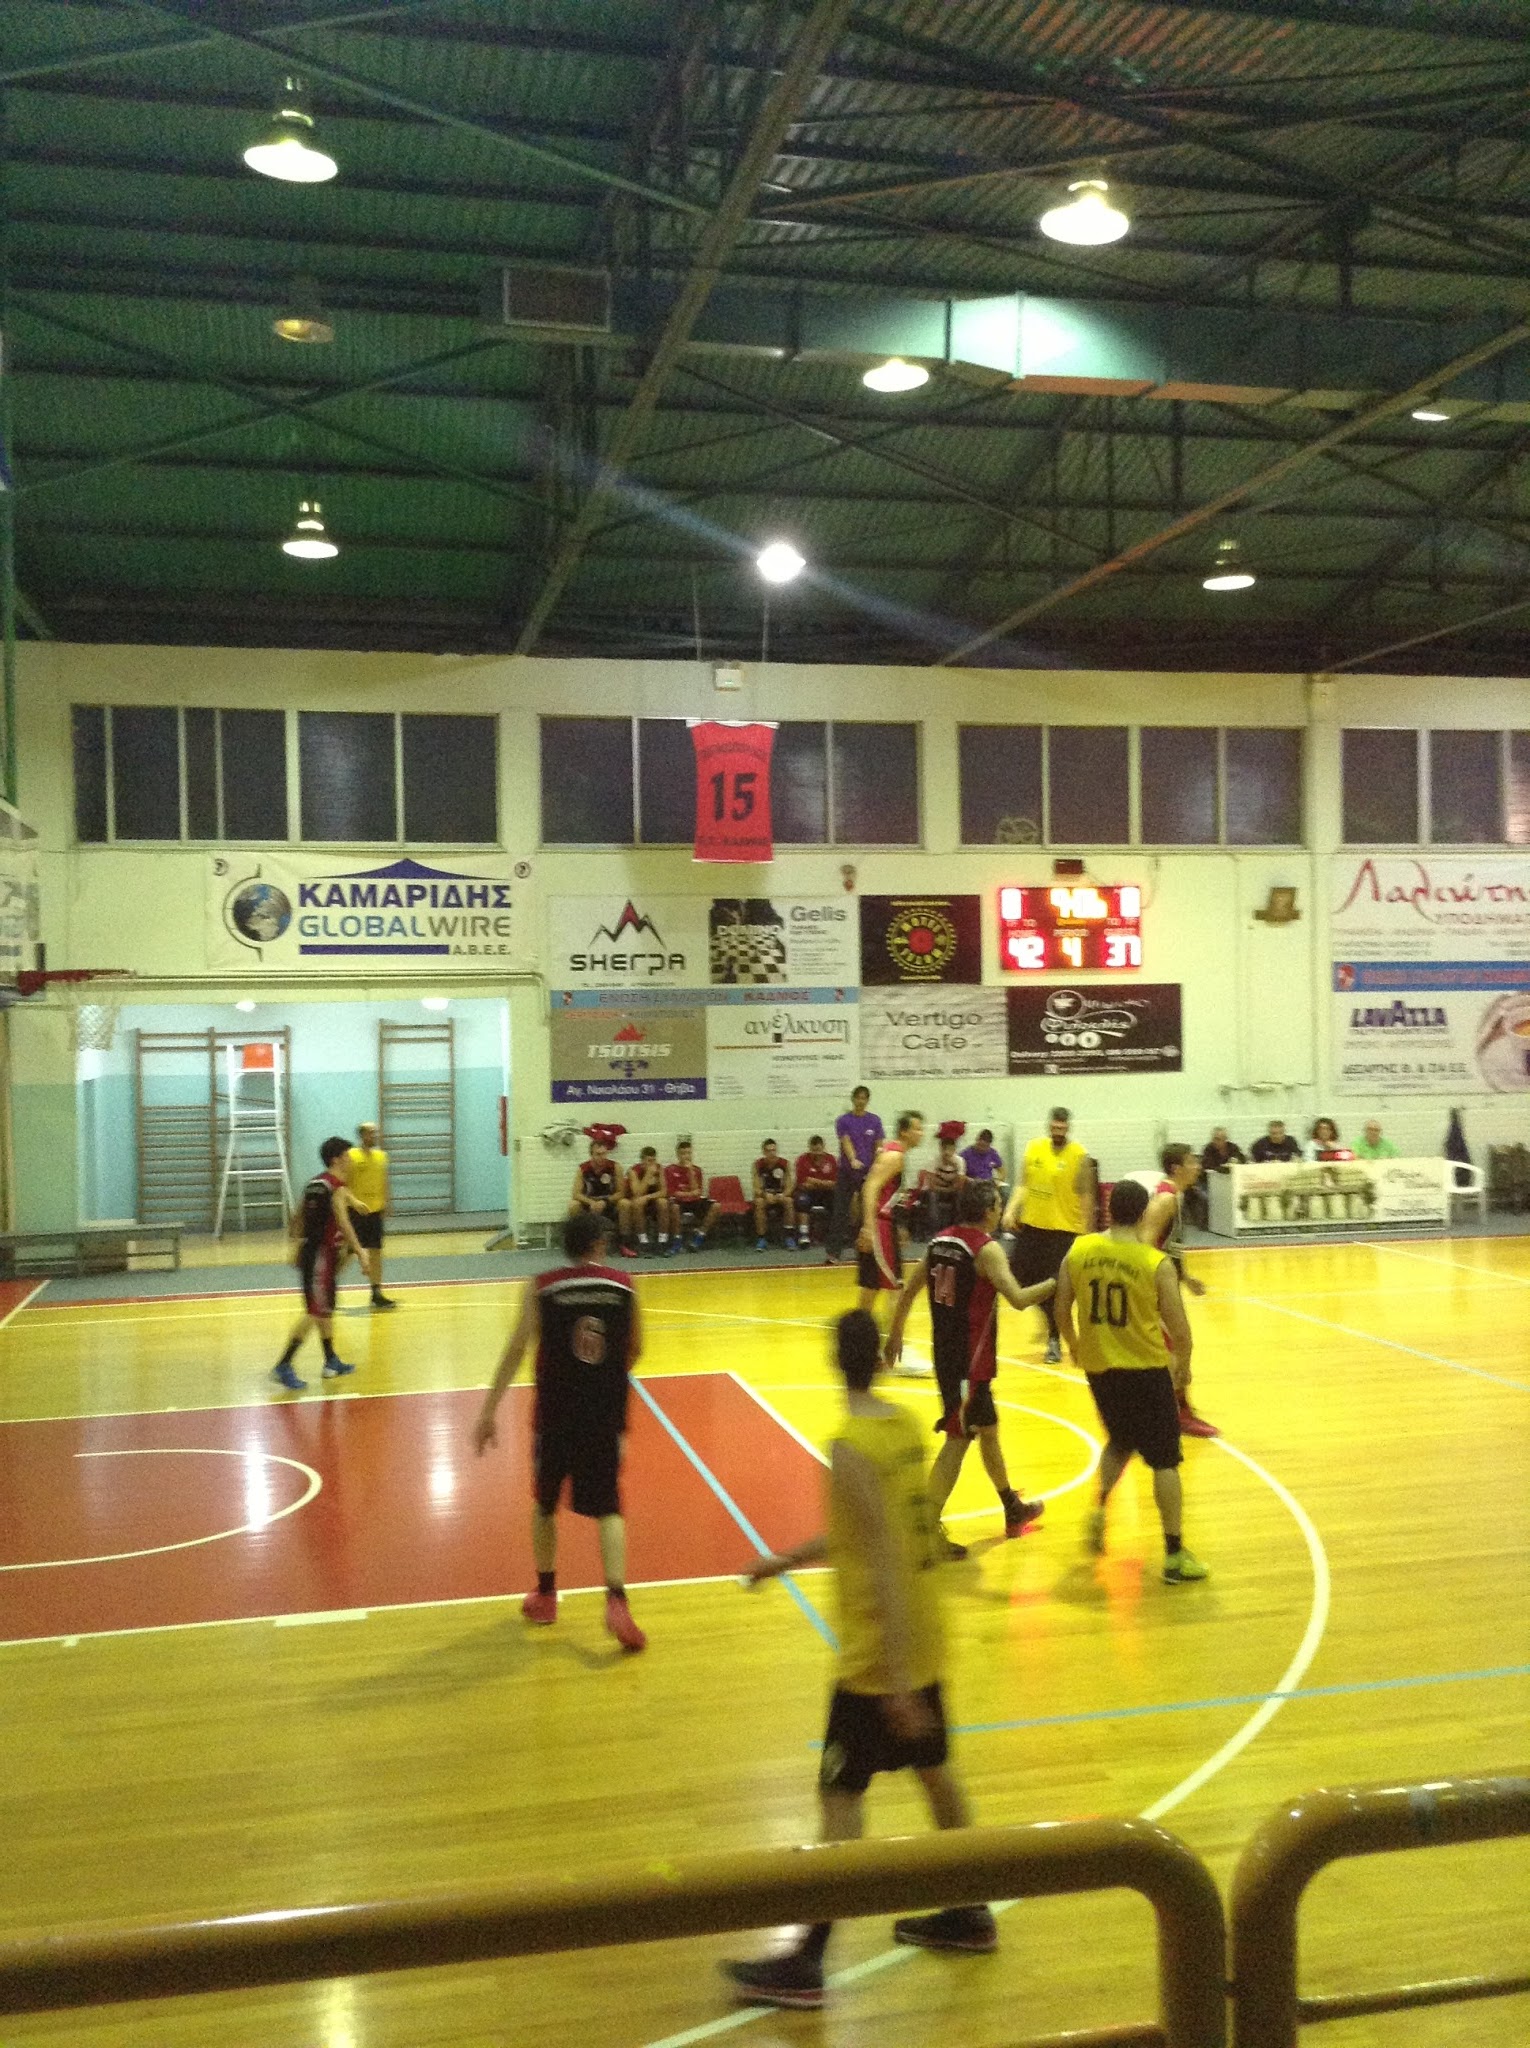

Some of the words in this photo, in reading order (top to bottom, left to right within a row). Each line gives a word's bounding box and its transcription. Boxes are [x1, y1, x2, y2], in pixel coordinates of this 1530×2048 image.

[711, 771, 757, 822] 15
[298, 883, 512, 909] ΚΑΜΑΡΙΔΗΣ
[299, 915, 511, 938] GLOBALWIRE
[790, 905, 847, 922] Gelis
[1008, 937, 1045, 968] 42
[1061, 937, 1082, 967] 4
[1105, 936, 1141, 967] 37
[744, 1008, 849, 1044] ανέλκυση
[885, 1010, 983, 1030] Vertigo
[1350, 1000, 1448, 1027] LAVAZZA
[902, 1034, 967, 1050] Cafe
[1088, 1278, 1129, 1328] 10
